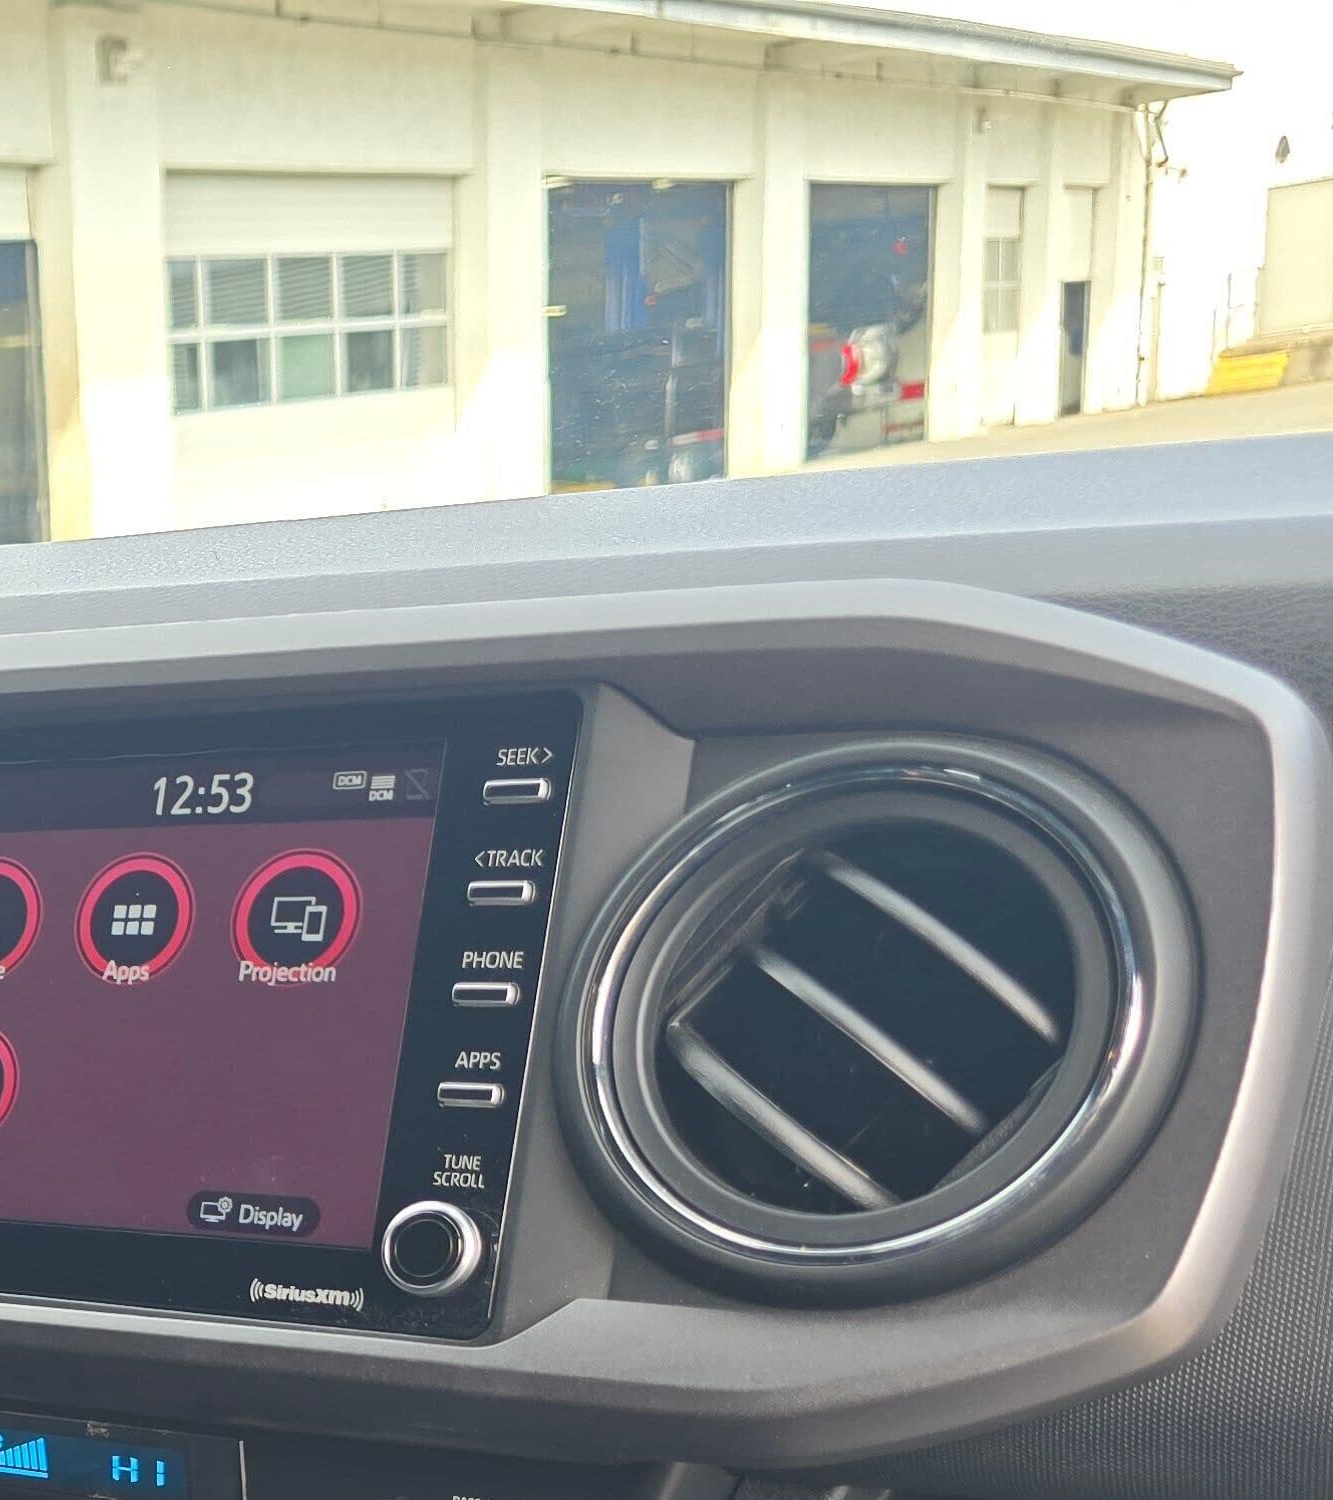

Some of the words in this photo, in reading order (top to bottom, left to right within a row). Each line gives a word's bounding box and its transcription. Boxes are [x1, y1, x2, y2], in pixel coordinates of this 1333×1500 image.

[337, 775, 362, 786] DCM
[153, 772, 254, 816] 12:53
[368, 790, 394, 802] DCM
[461, 951, 524, 969] PHONE
[102, 960, 150, 984] Apps
[238, 960, 337, 986] Projection
[454, 1051, 501, 1070] APPS
[443, 1154, 482, 1171] TUNE
[432, 1171, 485, 1189] SCROLL
[238, 1204, 303, 1233] Display
[111, 1455, 165, 1487] HI
